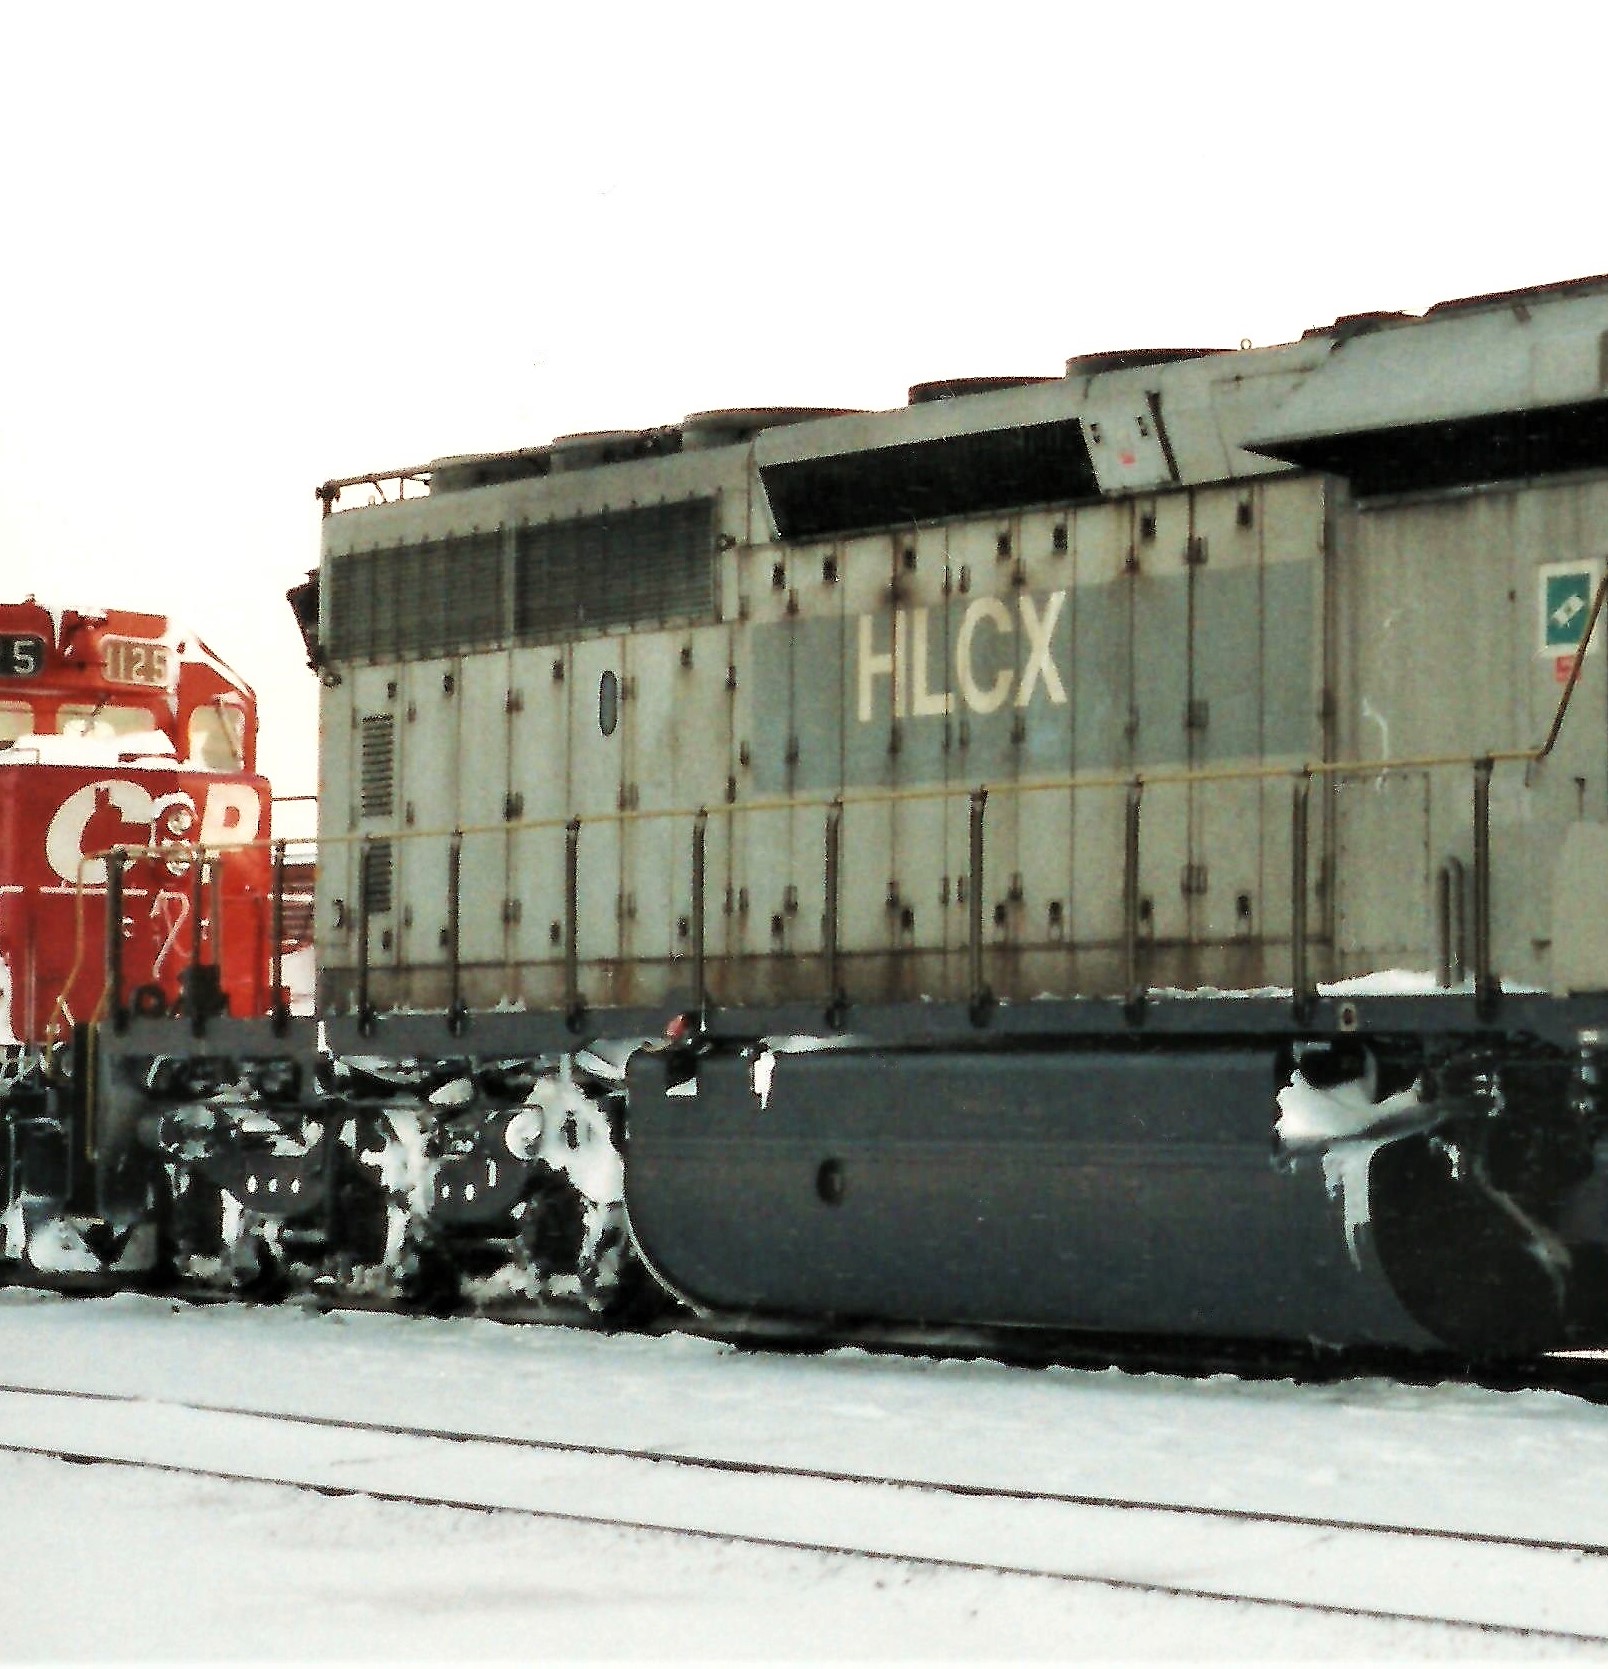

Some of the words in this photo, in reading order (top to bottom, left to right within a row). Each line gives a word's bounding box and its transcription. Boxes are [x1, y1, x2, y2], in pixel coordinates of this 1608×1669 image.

[106, 646, 166, 681] 1125
[857, 591, 1067, 722] HLCX
[45, 780, 261, 885] CP
